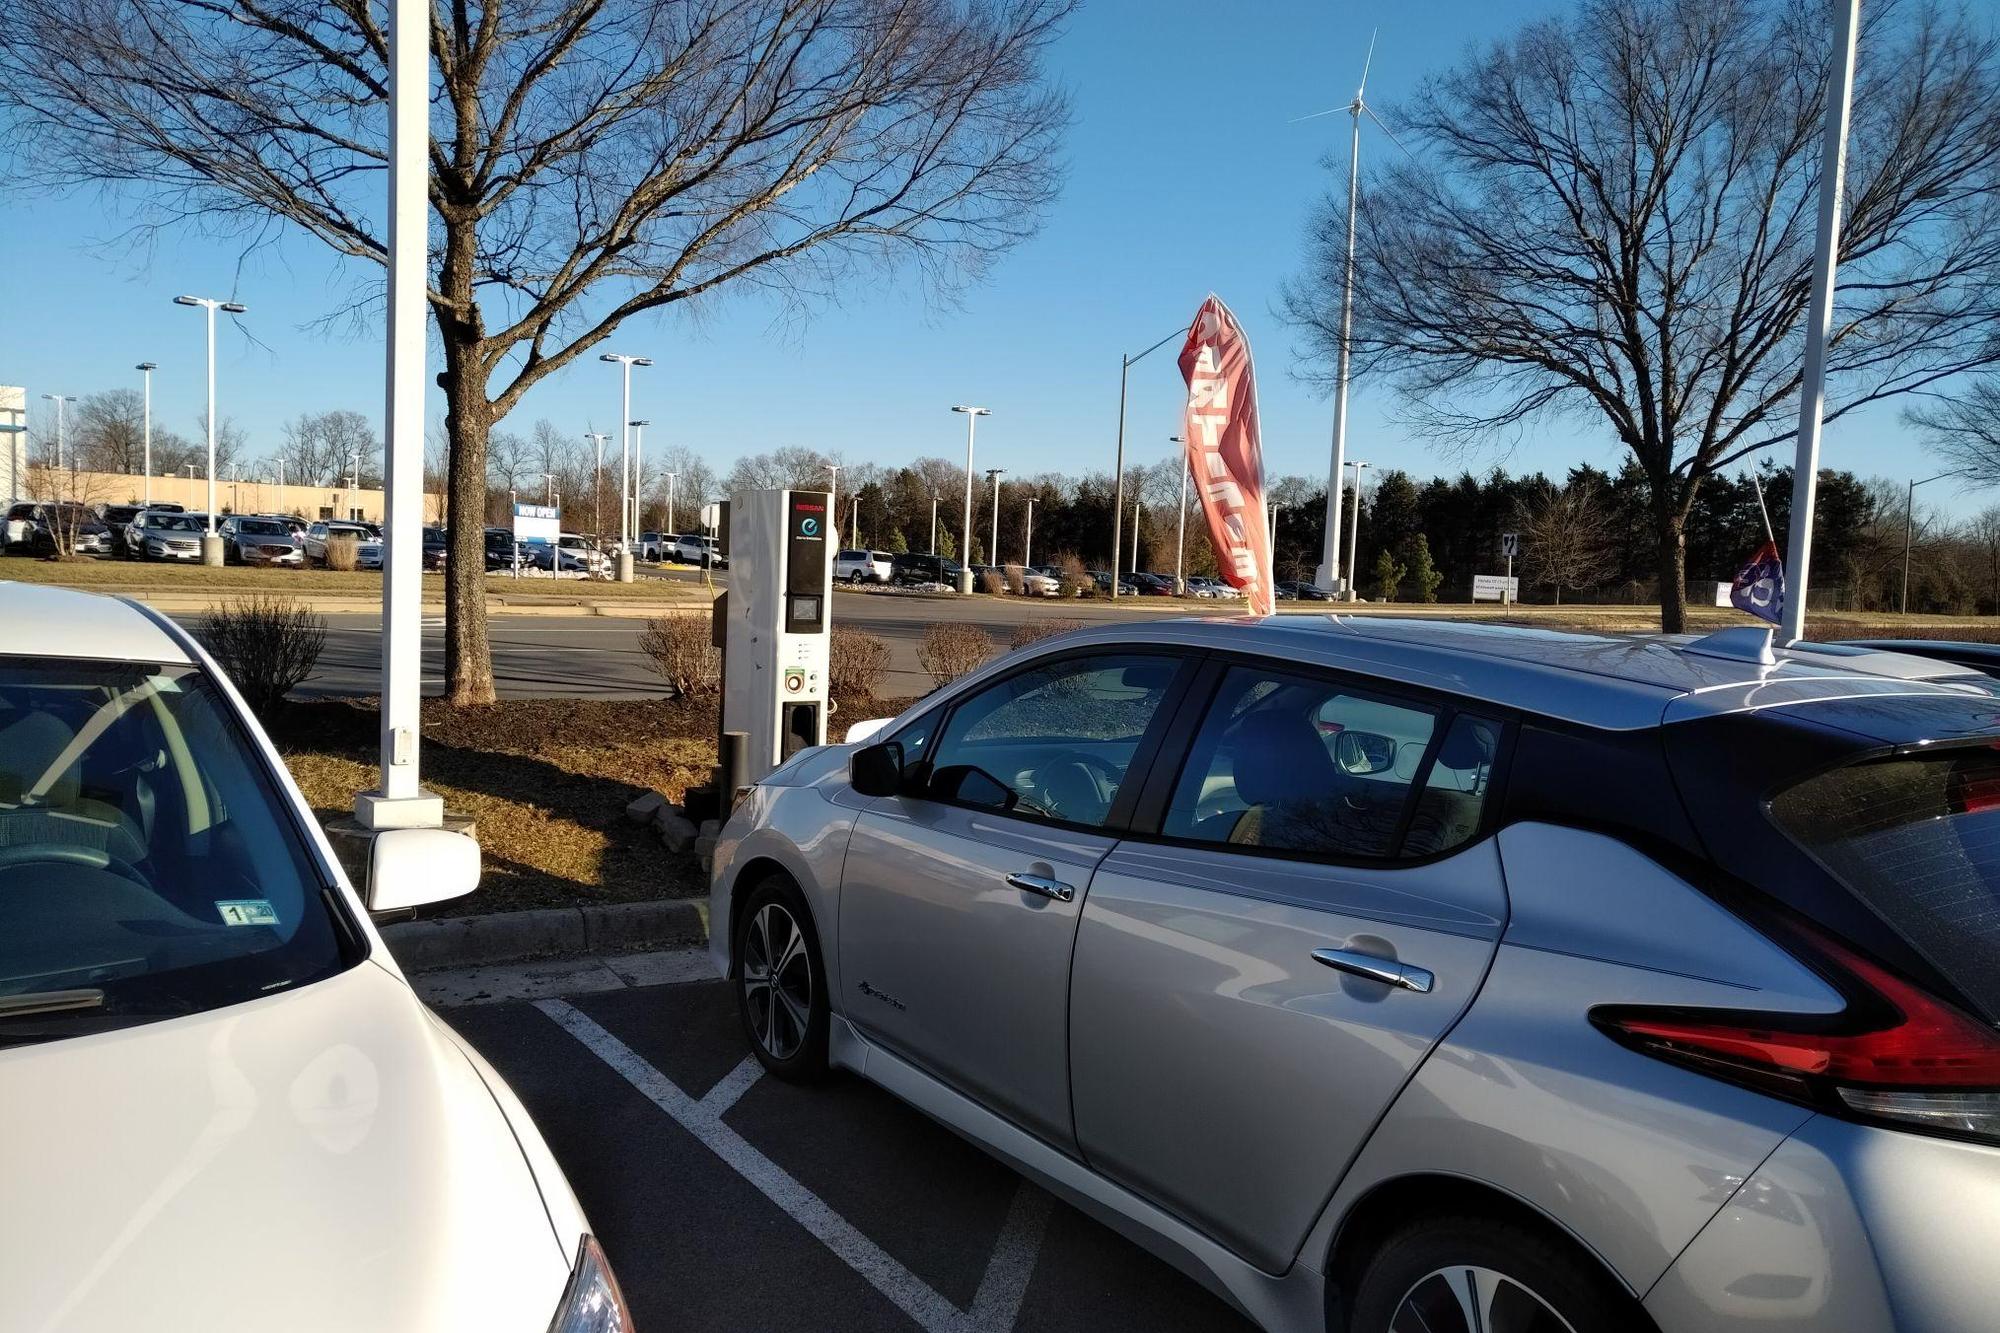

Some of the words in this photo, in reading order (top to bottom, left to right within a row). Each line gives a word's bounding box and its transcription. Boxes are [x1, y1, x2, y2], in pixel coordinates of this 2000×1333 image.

[518, 504, 536, 517] NOW
[537, 506, 556, 518] OPEN
[229, 907, 242, 921] 1
